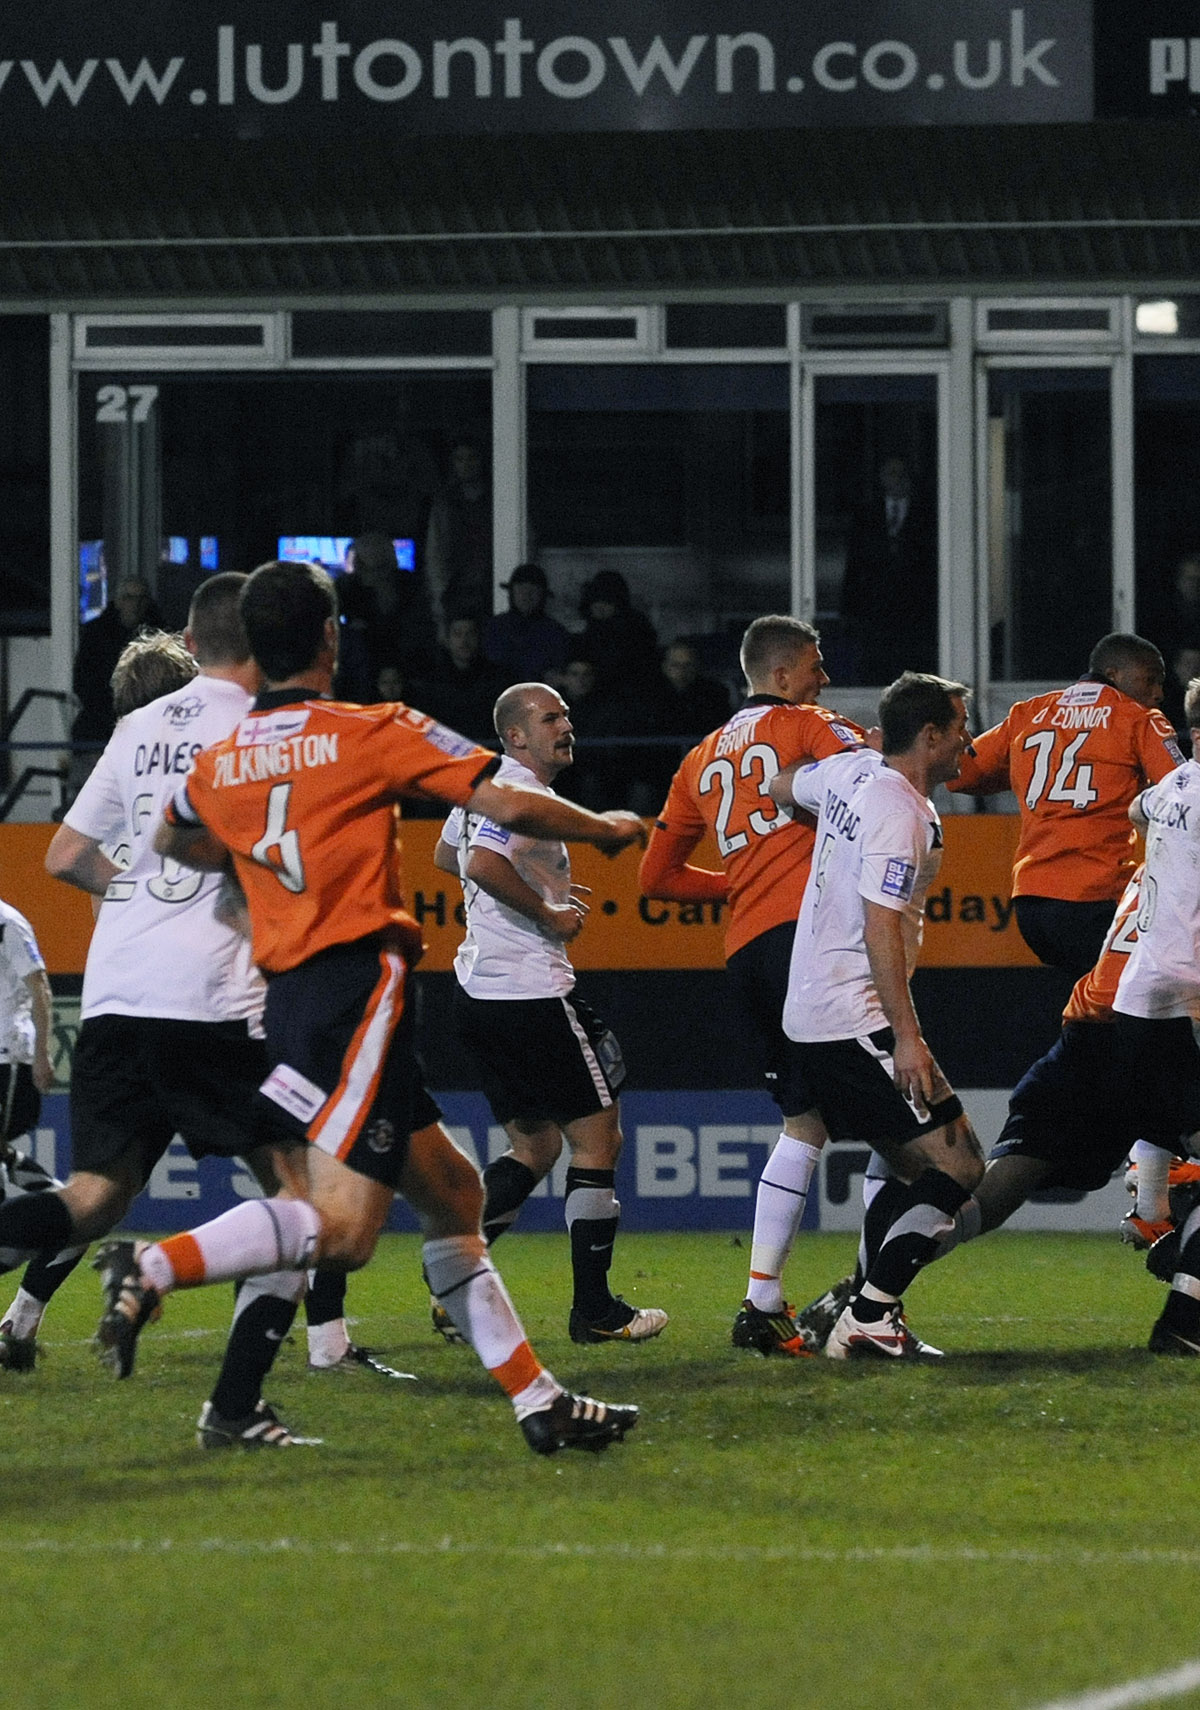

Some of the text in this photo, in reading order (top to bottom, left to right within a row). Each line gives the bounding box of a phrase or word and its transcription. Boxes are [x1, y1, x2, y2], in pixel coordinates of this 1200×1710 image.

[0, 9, 1060, 106] ww.lutontown.co.uk
[96, 385, 158, 422] 27
[699, 743, 793, 859] 23
[1023, 729, 1098, 811] 14
